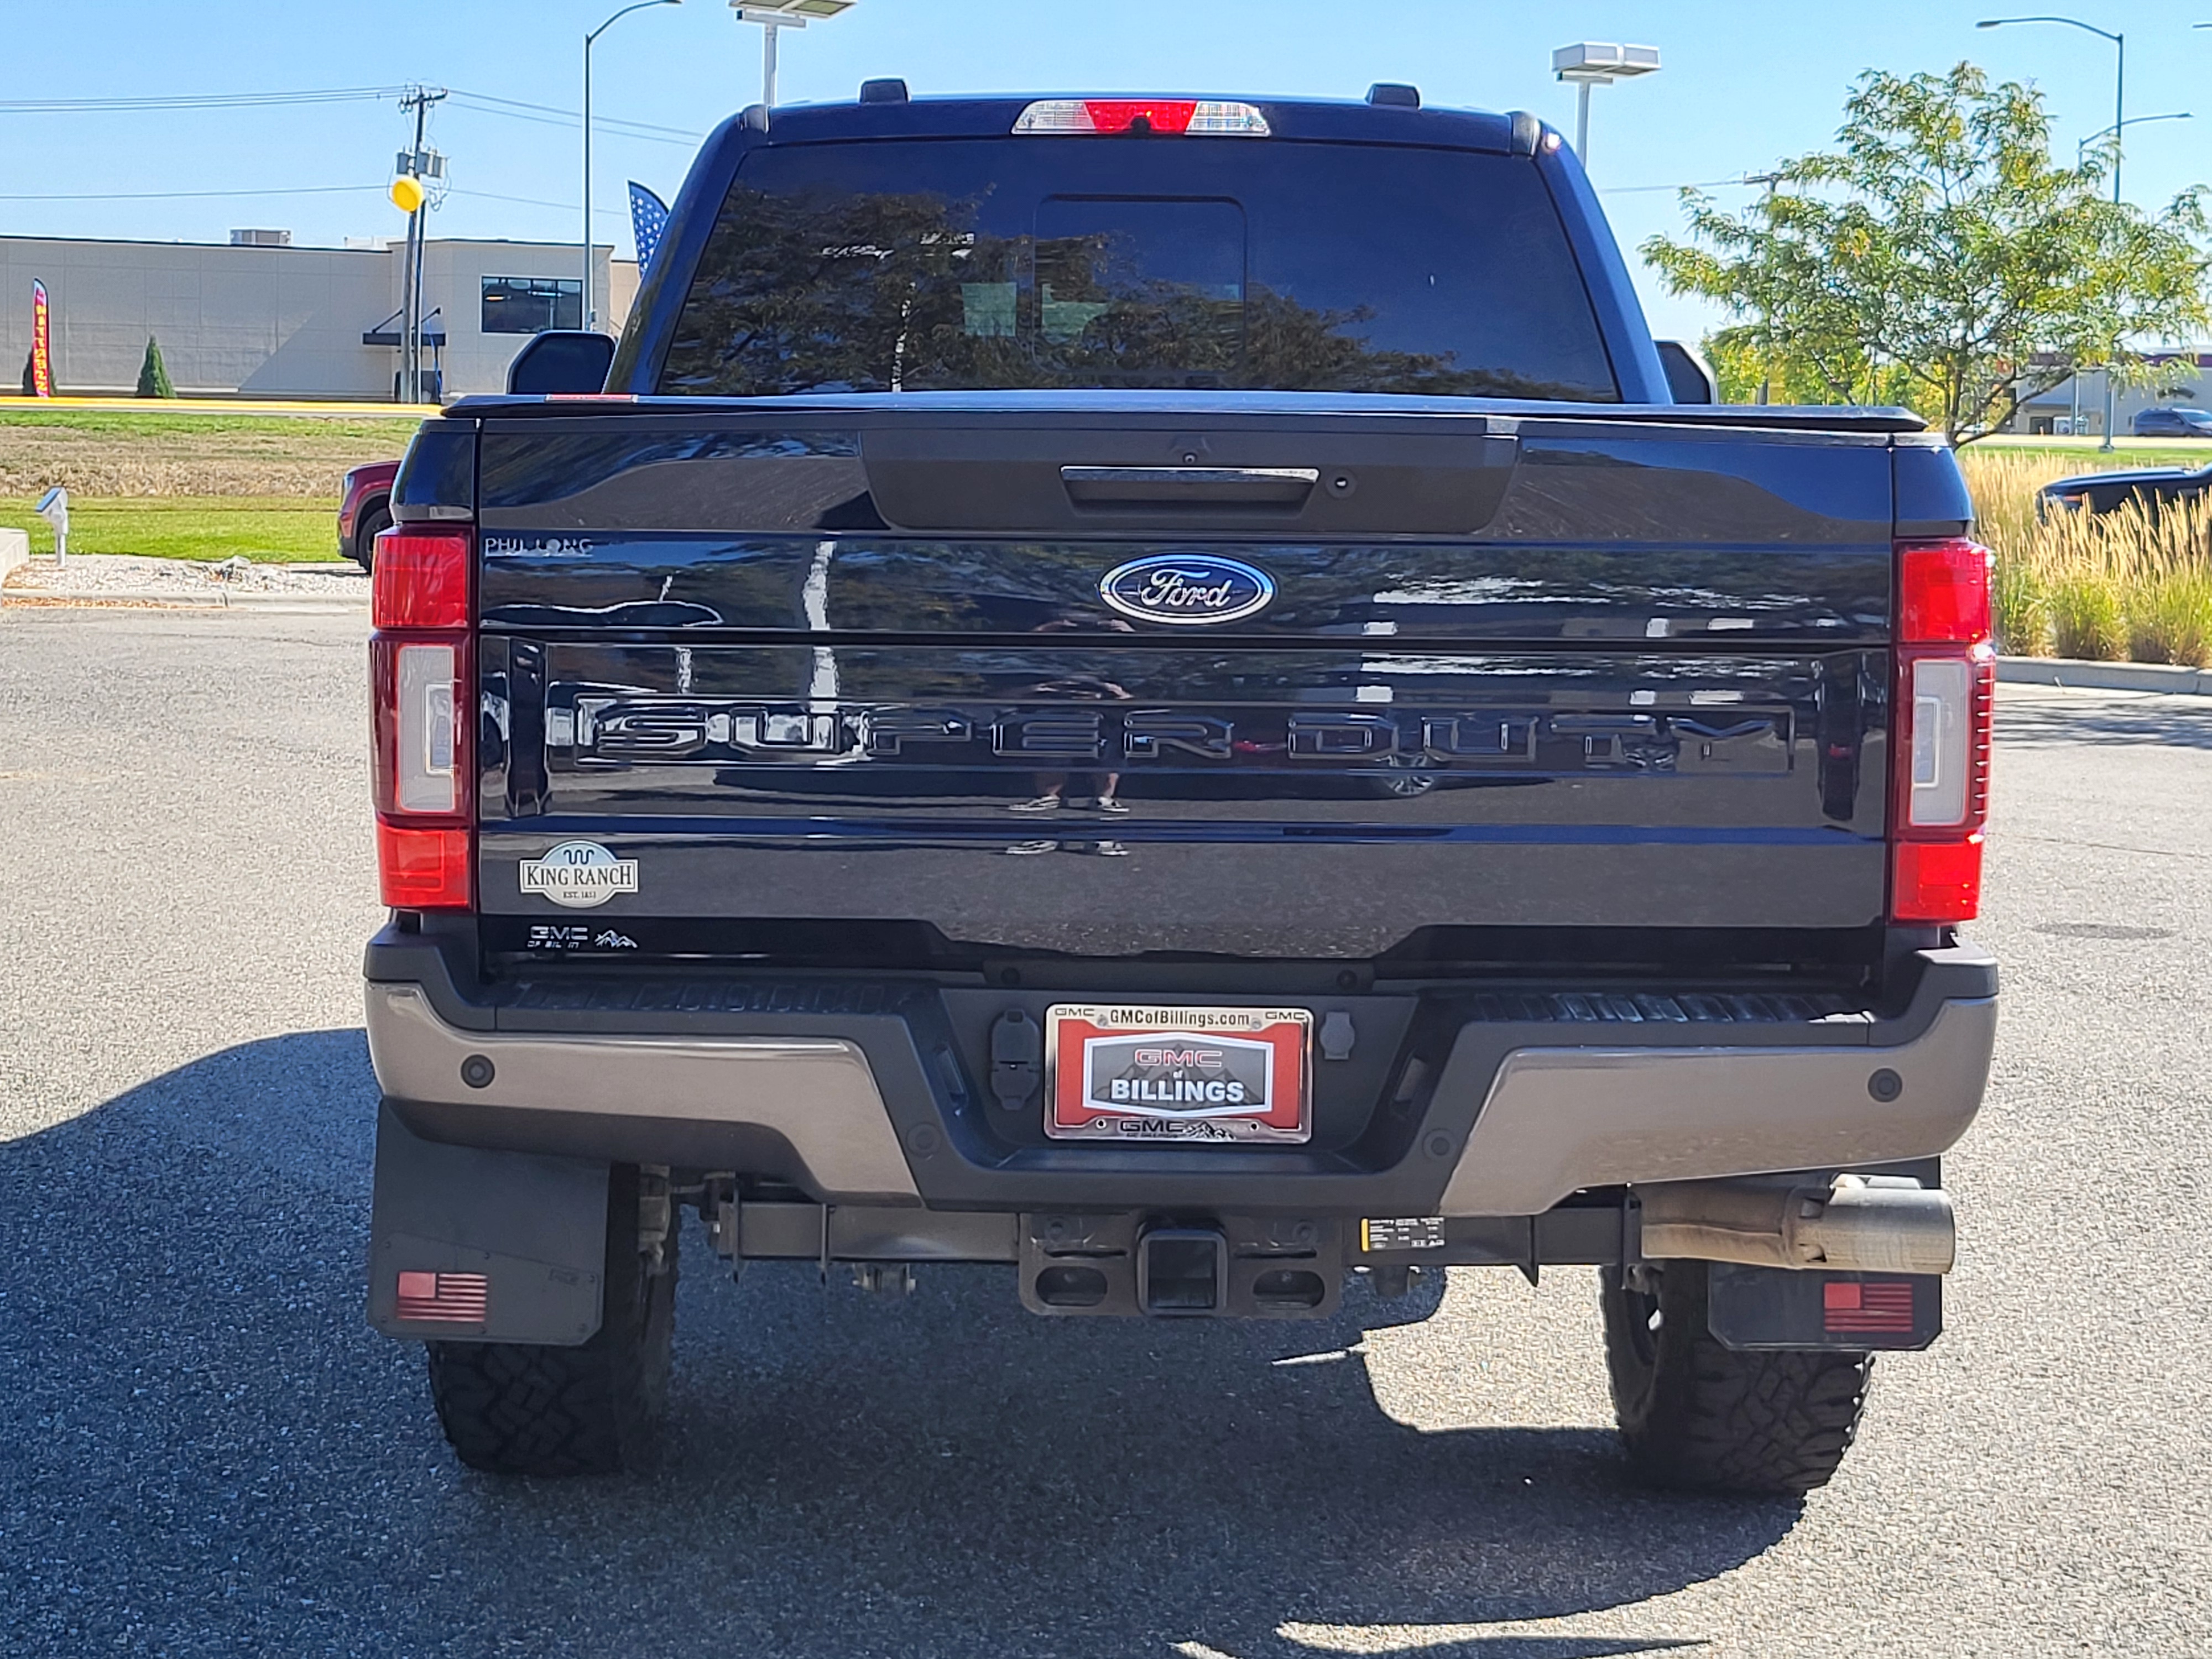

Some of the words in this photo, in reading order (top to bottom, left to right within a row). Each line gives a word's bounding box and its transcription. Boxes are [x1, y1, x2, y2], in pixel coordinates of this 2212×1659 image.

[485, 538, 528, 556] PHIL
[1140, 568, 1233, 607] Ford
[596, 706, 1234, 760] SUPER
[1287, 711, 1773, 766] DUTY
[526, 865, 568, 885] KING
[574, 865, 632, 885] RANCH
[530, 926, 588, 940] GMC
[1055, 1008, 1095, 1016] GMC
[1110, 1009, 1250, 1028] GMCofBillings.com
[1265, 1011, 1306, 1020] GMC
[1134, 1048, 1223, 1067] GMC
[1110, 1079, 1245, 1102] BILLINGS
[1120, 1120, 1185, 1133] GMC
